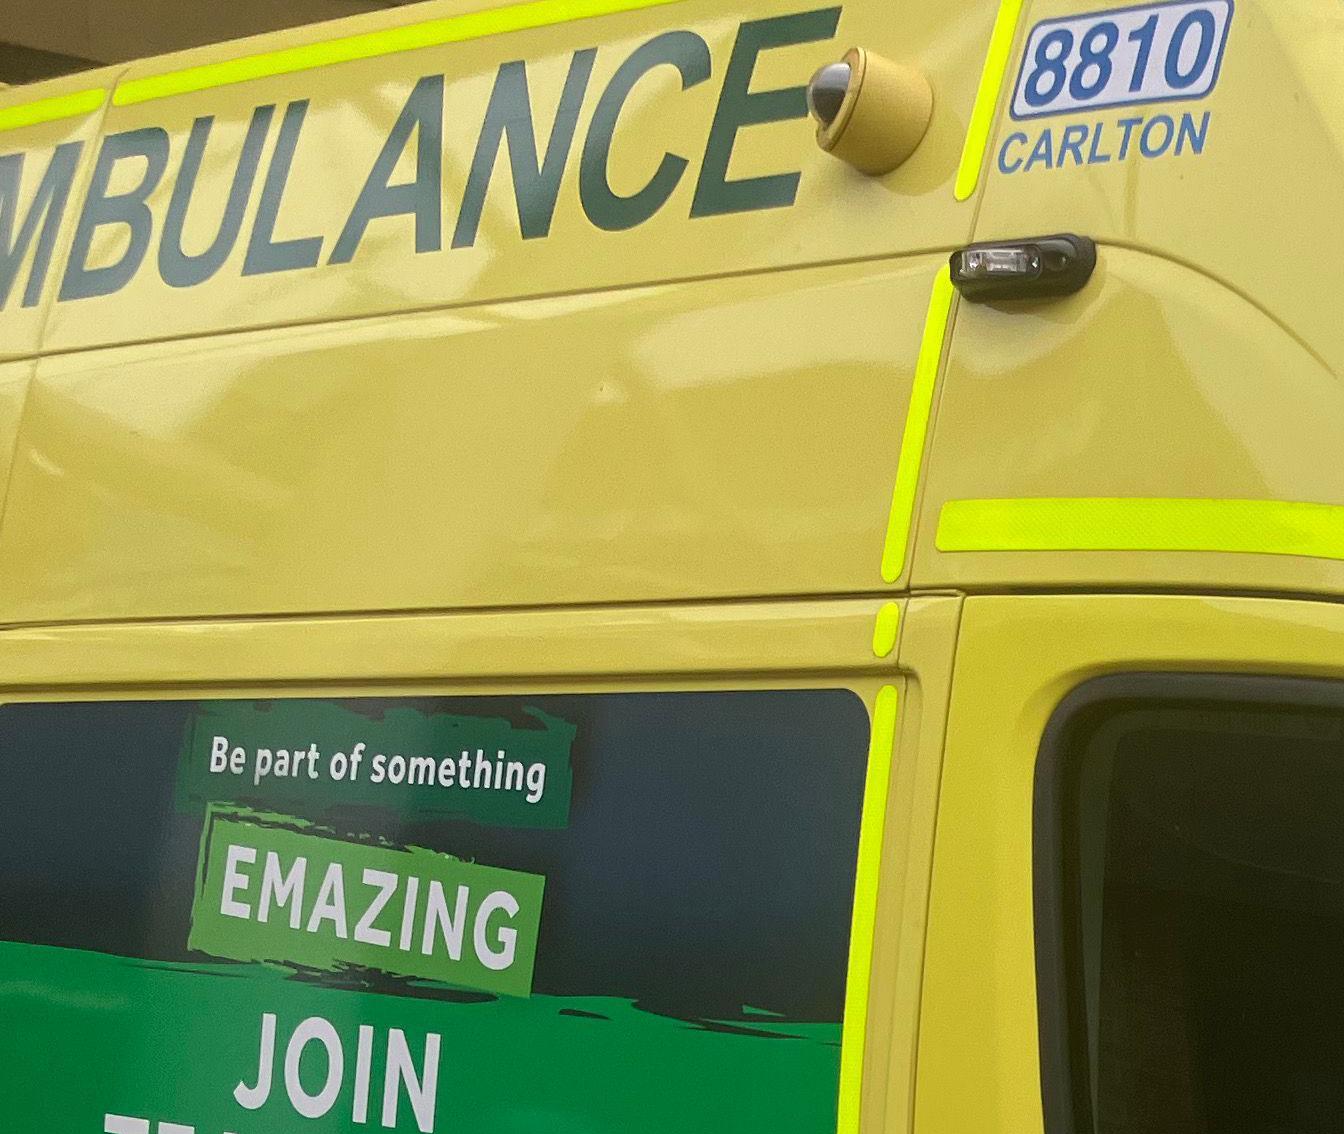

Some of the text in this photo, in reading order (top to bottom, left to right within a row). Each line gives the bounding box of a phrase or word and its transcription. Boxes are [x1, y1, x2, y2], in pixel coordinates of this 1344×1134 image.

[1024, 8, 1216, 108] 8810
[0, 6, 843, 312] MBULANCE
[997, 111, 1211, 175] CARLTON
[209, 735, 547, 804] Be part of something
[219, 844, 521, 971] EMAZING
[233, 1012, 442, 1134] JOIN
